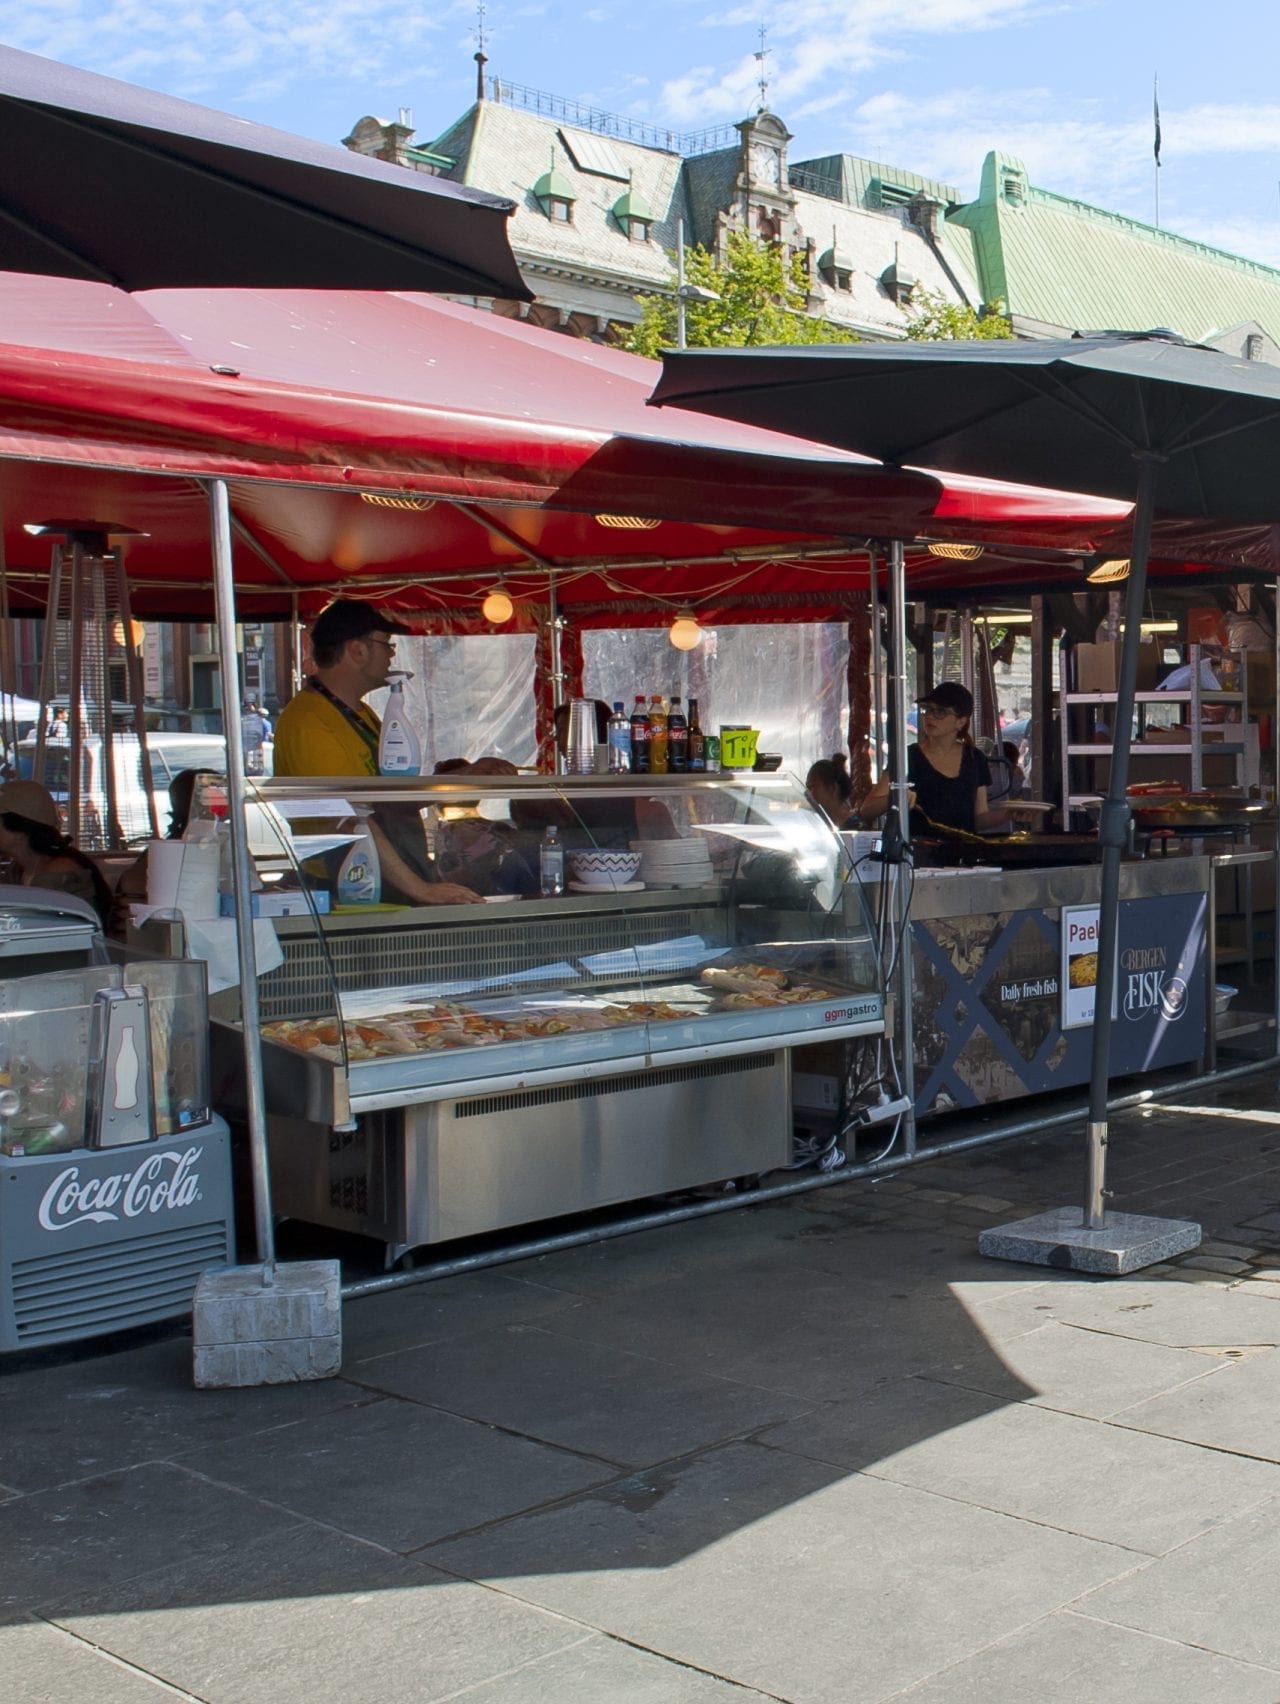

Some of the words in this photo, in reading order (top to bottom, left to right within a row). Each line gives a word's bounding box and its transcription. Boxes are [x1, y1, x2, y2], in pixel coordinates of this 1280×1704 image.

[1069, 919, 1100, 942] Pael
[1120, 946, 1166, 970] BERGEN
[1001, 984, 1021, 1002] Daily
[1023, 980, 1042, 998] fresh
[1044, 978, 1057, 994] fish
[1125, 969, 1184, 1015] FISK
[825, 1004, 877, 1022] ggmgastro
[38, 1146, 203, 1231] Coca-Cola
